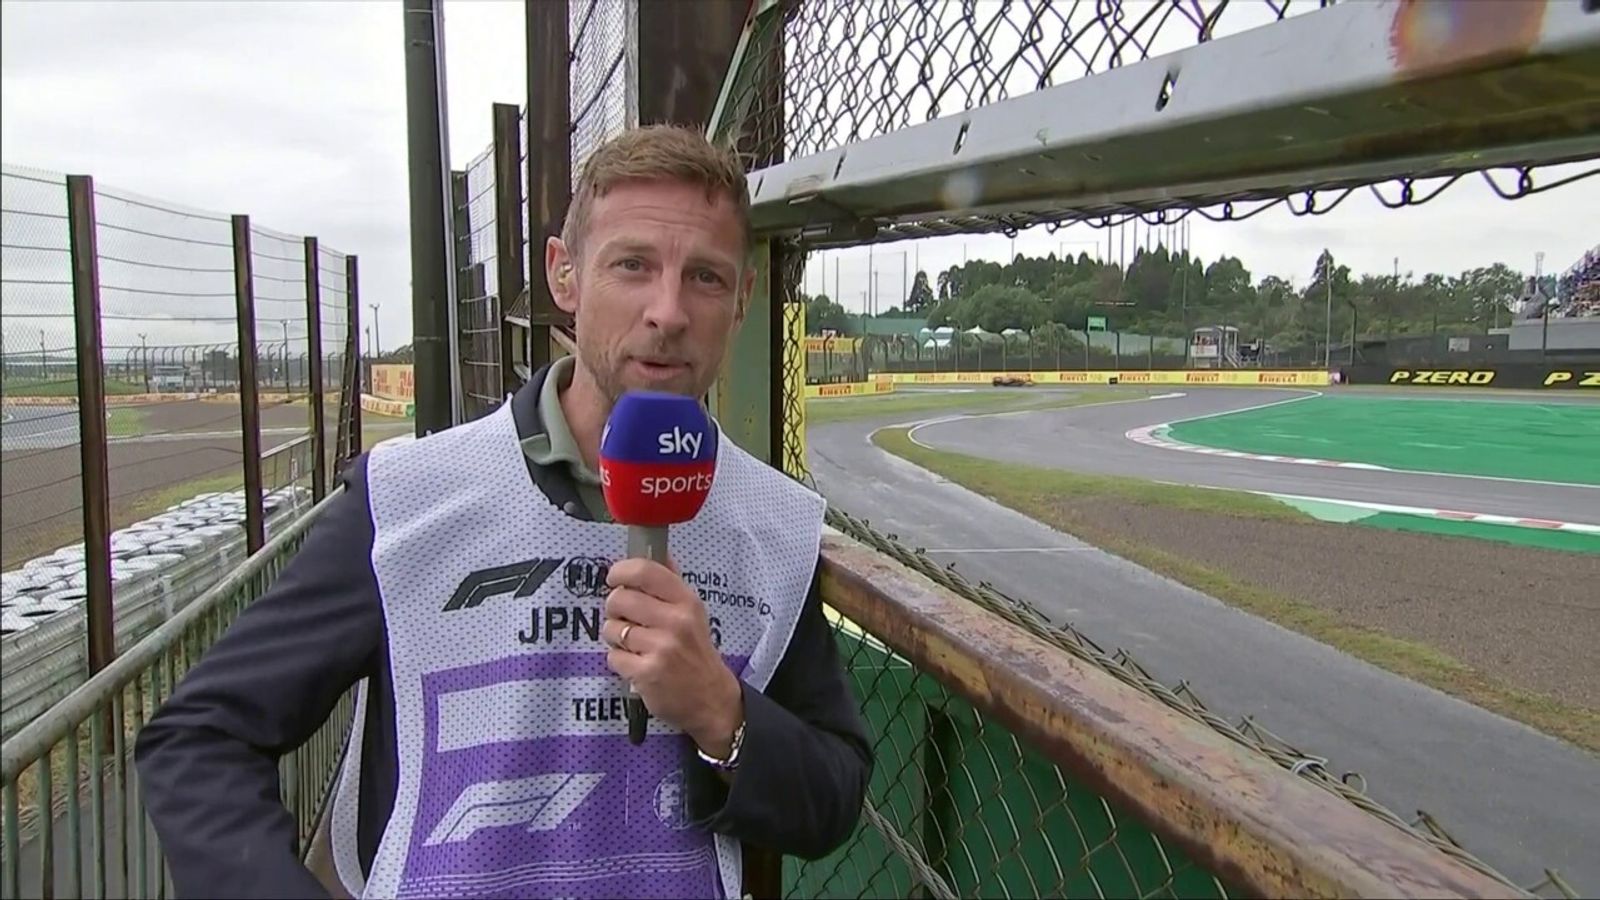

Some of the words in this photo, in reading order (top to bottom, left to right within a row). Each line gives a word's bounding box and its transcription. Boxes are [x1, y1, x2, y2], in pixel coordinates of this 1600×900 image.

[1258, 373, 1297, 383] PIRELLI
[1391, 371, 1410, 383] P
[1411, 371, 1495, 384] ZERO
[1544, 372, 1572, 386] P
[658, 426, 703, 459] sky
[641, 472, 712, 498] sports
[682, 571, 721, 586] mula
[518, 606, 600, 643] JPN
